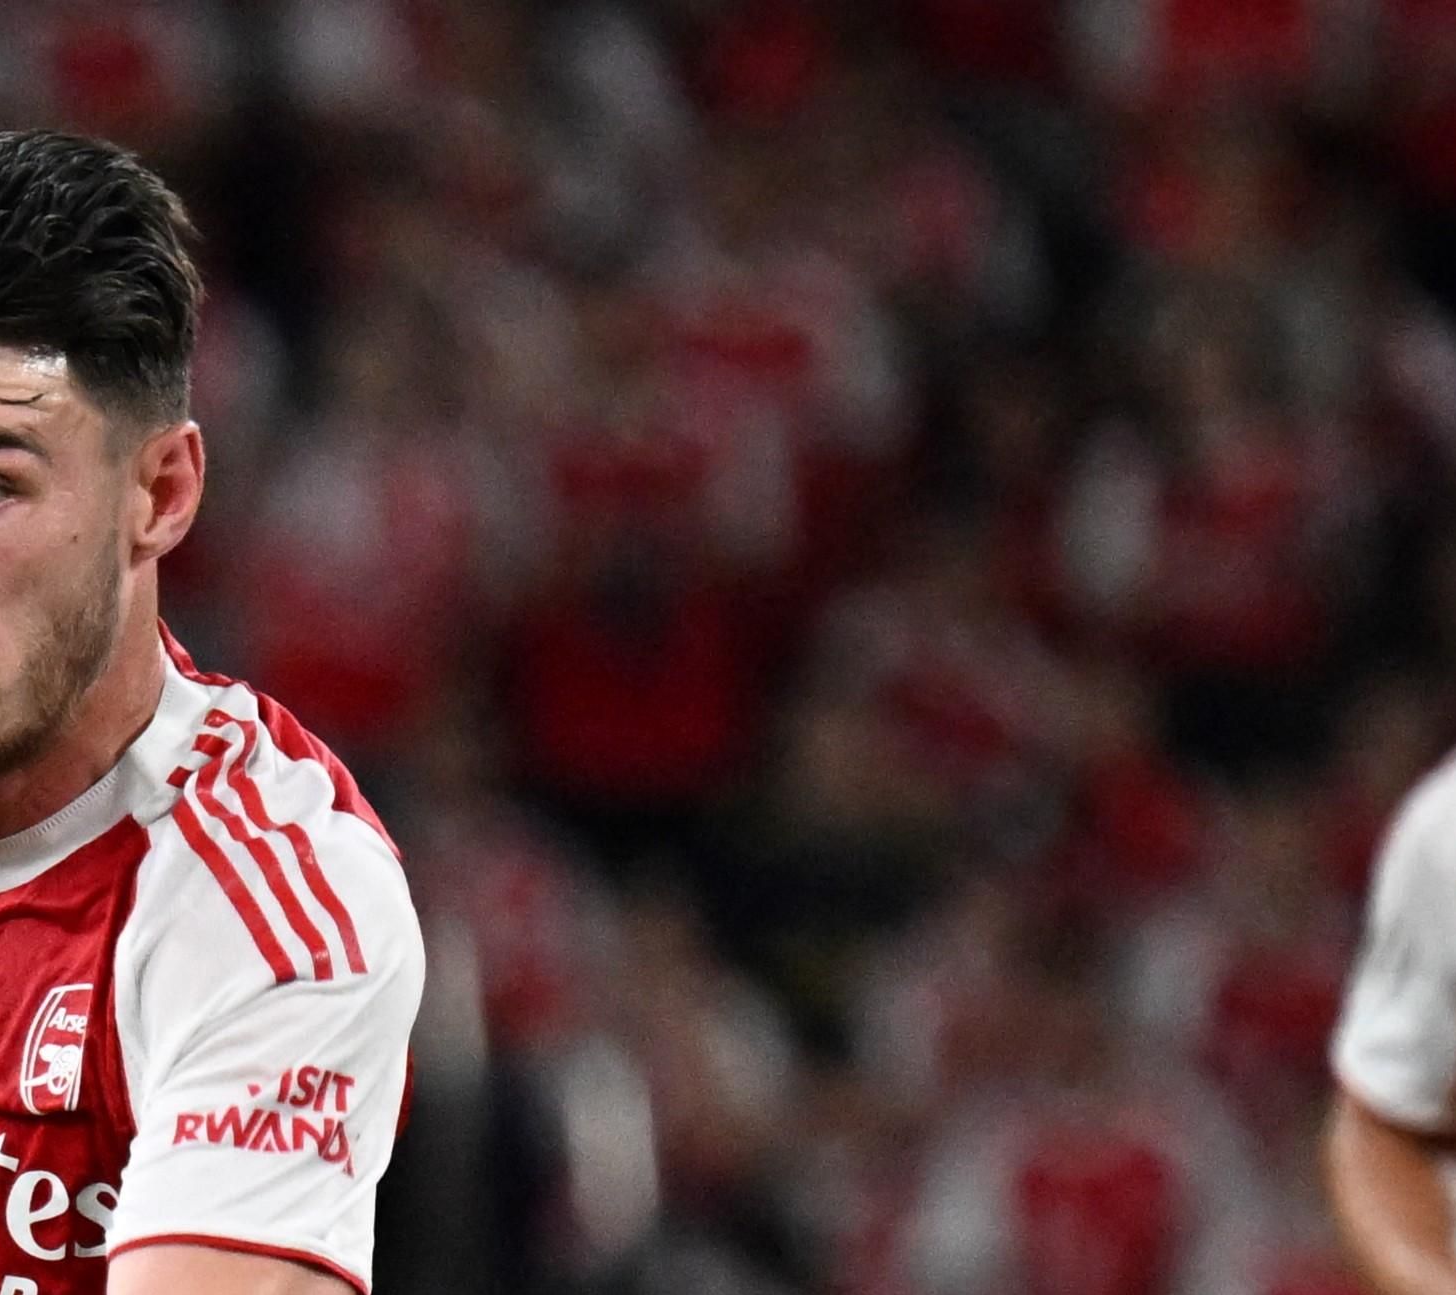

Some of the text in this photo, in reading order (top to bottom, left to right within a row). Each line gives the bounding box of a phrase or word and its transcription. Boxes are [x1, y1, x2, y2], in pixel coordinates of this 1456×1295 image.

[47, 1006, 88, 1035] Arse
[246, 1064, 356, 1114] ISIT
[172, 1104, 355, 1179] RWAND
